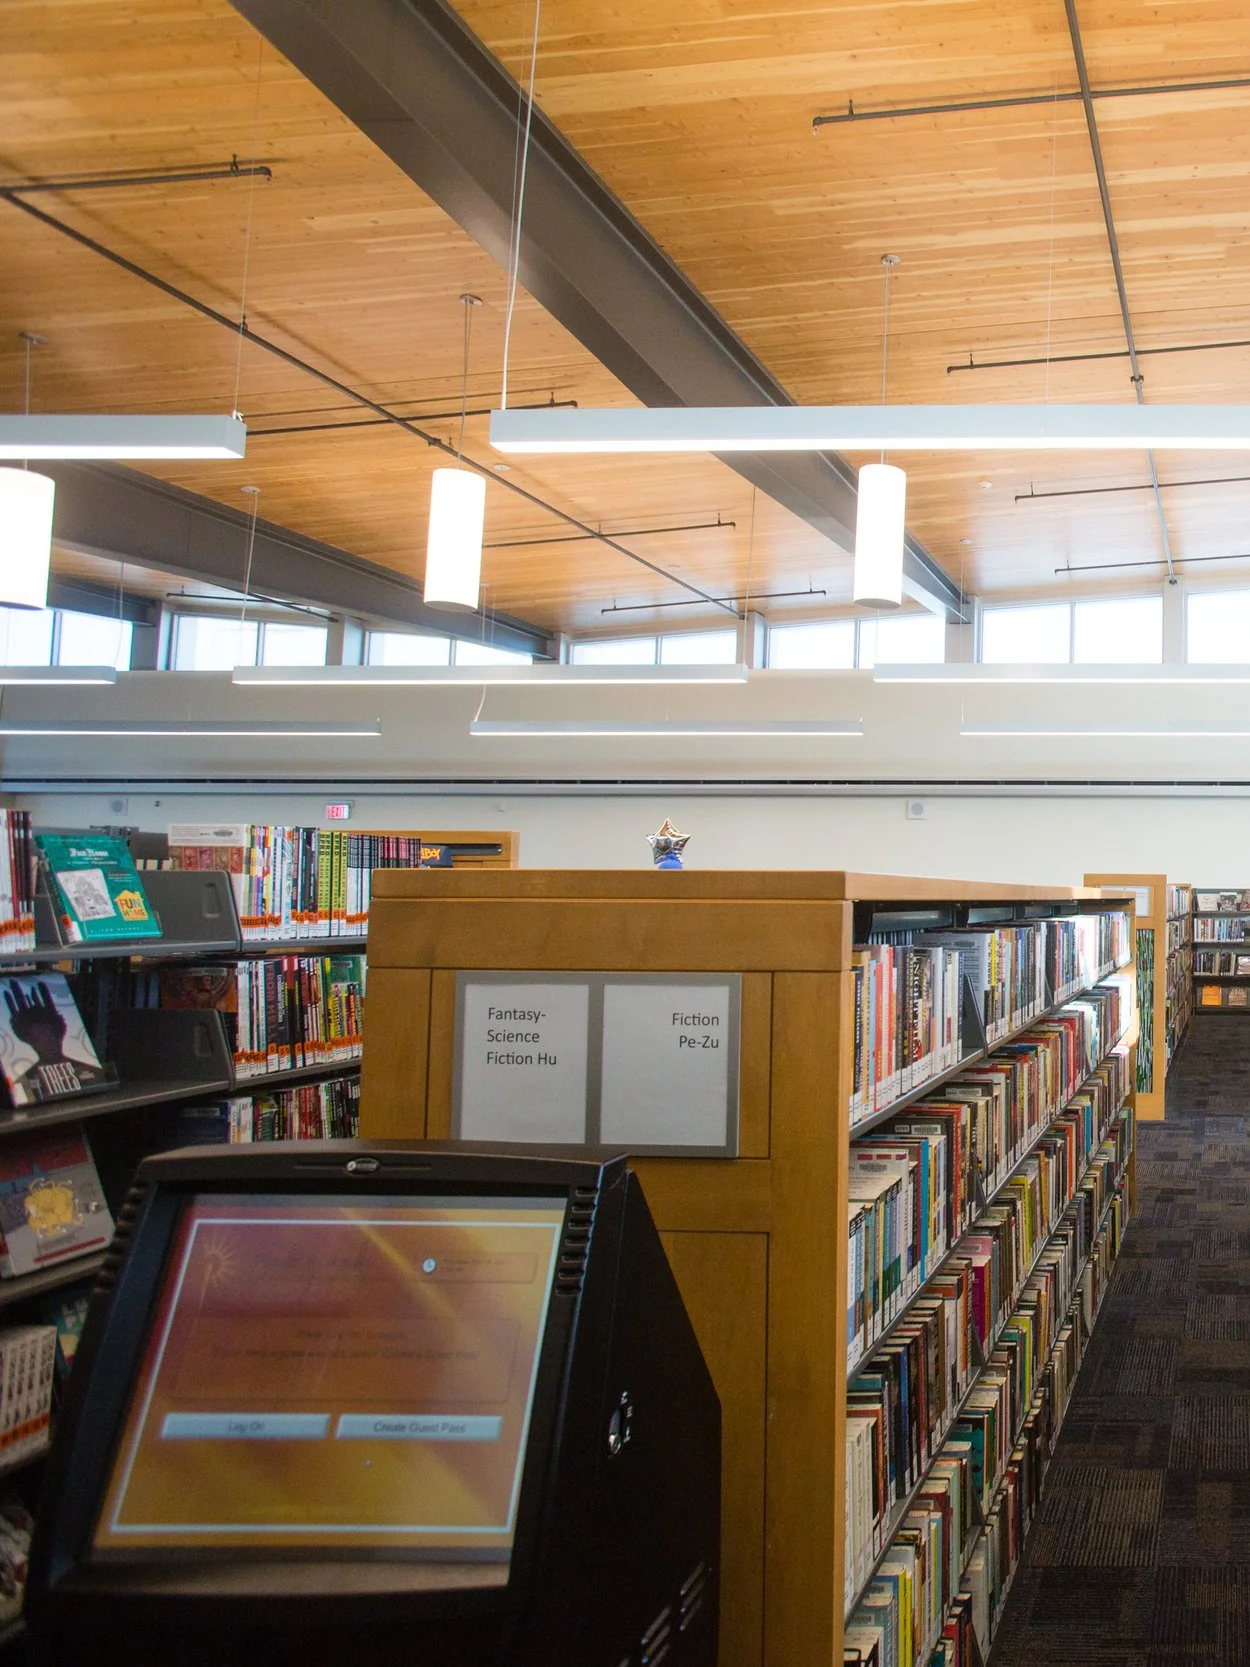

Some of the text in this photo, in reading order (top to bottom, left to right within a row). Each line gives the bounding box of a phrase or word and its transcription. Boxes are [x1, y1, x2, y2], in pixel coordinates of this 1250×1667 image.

[487, 1006, 547, 1023] Fantasy-
[672, 1012, 720, 1026] Fiction
[487, 1029, 540, 1043] Science
[679, 1035, 719, 1048] Pe-Zu
[486, 1052, 557, 1065] Fiction Hu
[38, 1061, 82, 1095] TREES
[373, 1421, 466, 1433] Create Guest Pass
